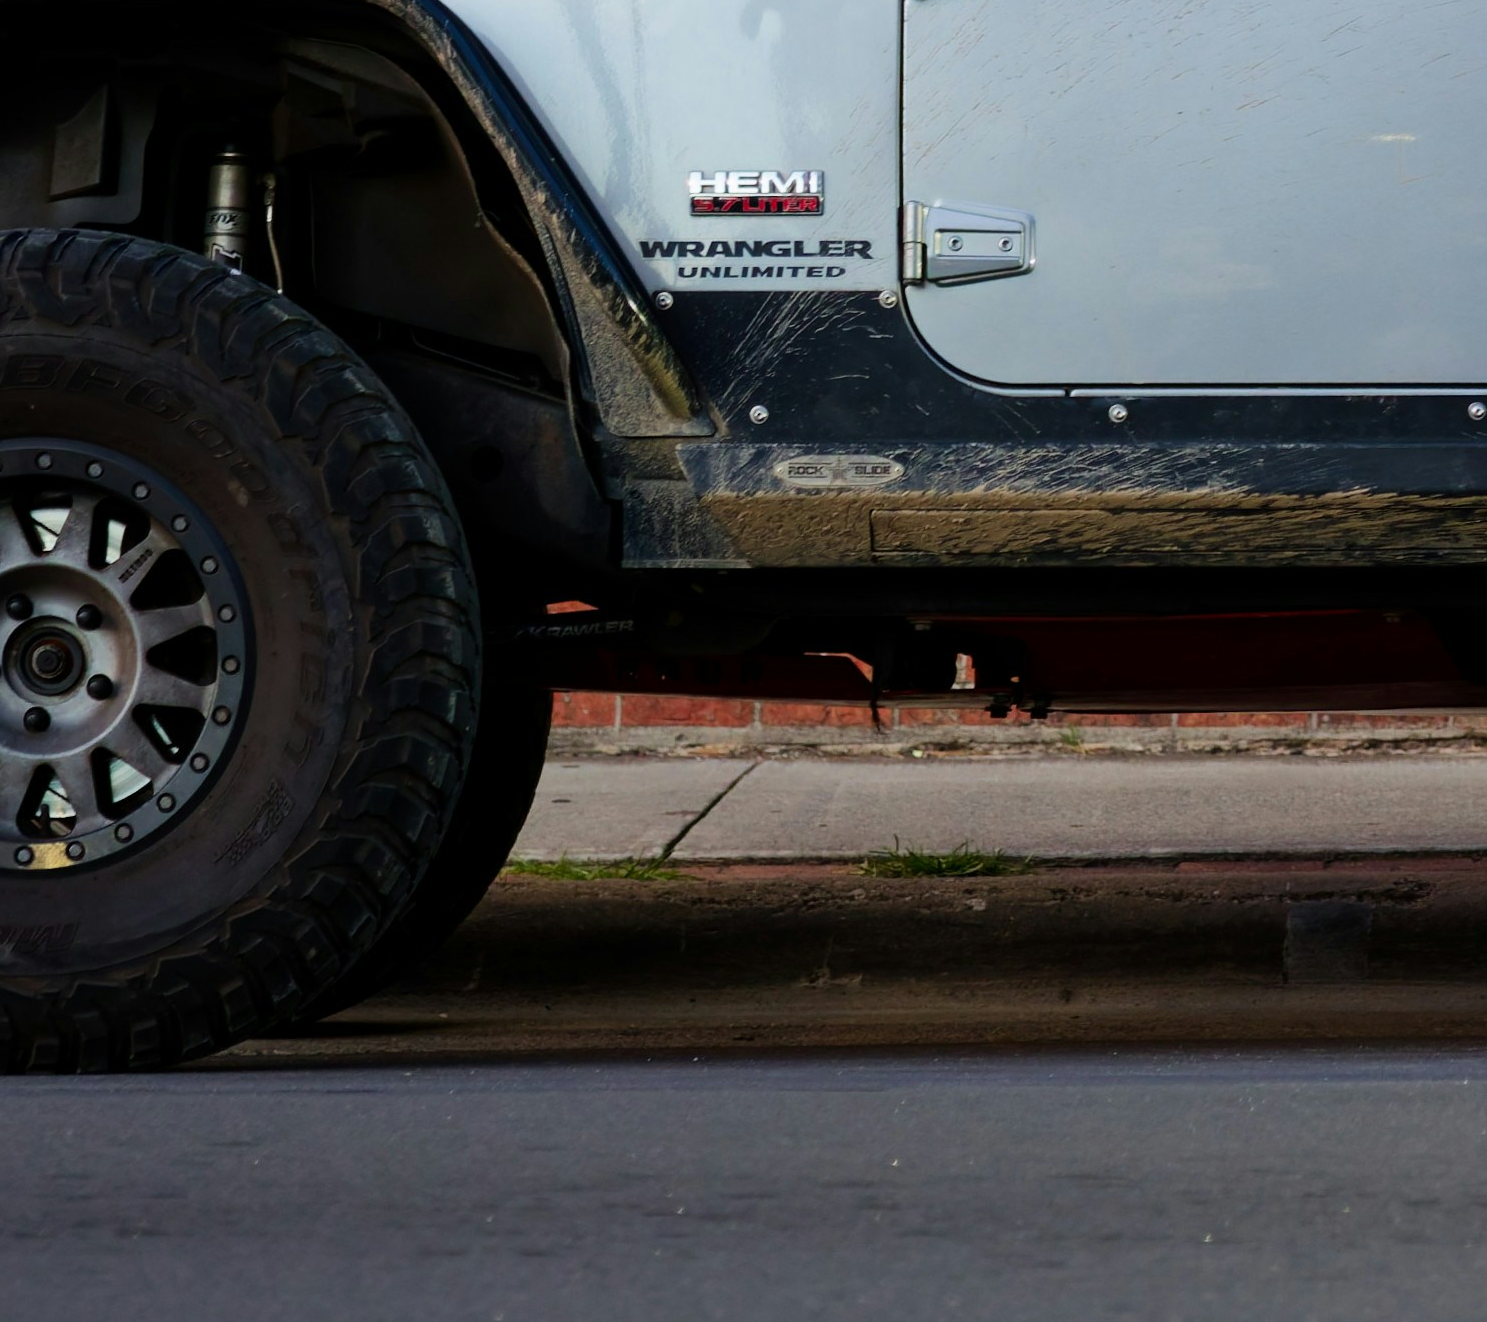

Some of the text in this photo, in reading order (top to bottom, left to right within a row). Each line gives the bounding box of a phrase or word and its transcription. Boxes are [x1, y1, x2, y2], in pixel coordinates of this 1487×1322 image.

[688, 170, 821, 194] HEMI
[693, 196, 819, 213] 5.7 LITER
[639, 240, 874, 260] WRANGLER
[677, 265, 846, 279] UNLIMITED
[788, 465, 891, 475] ROCK SLIDE
